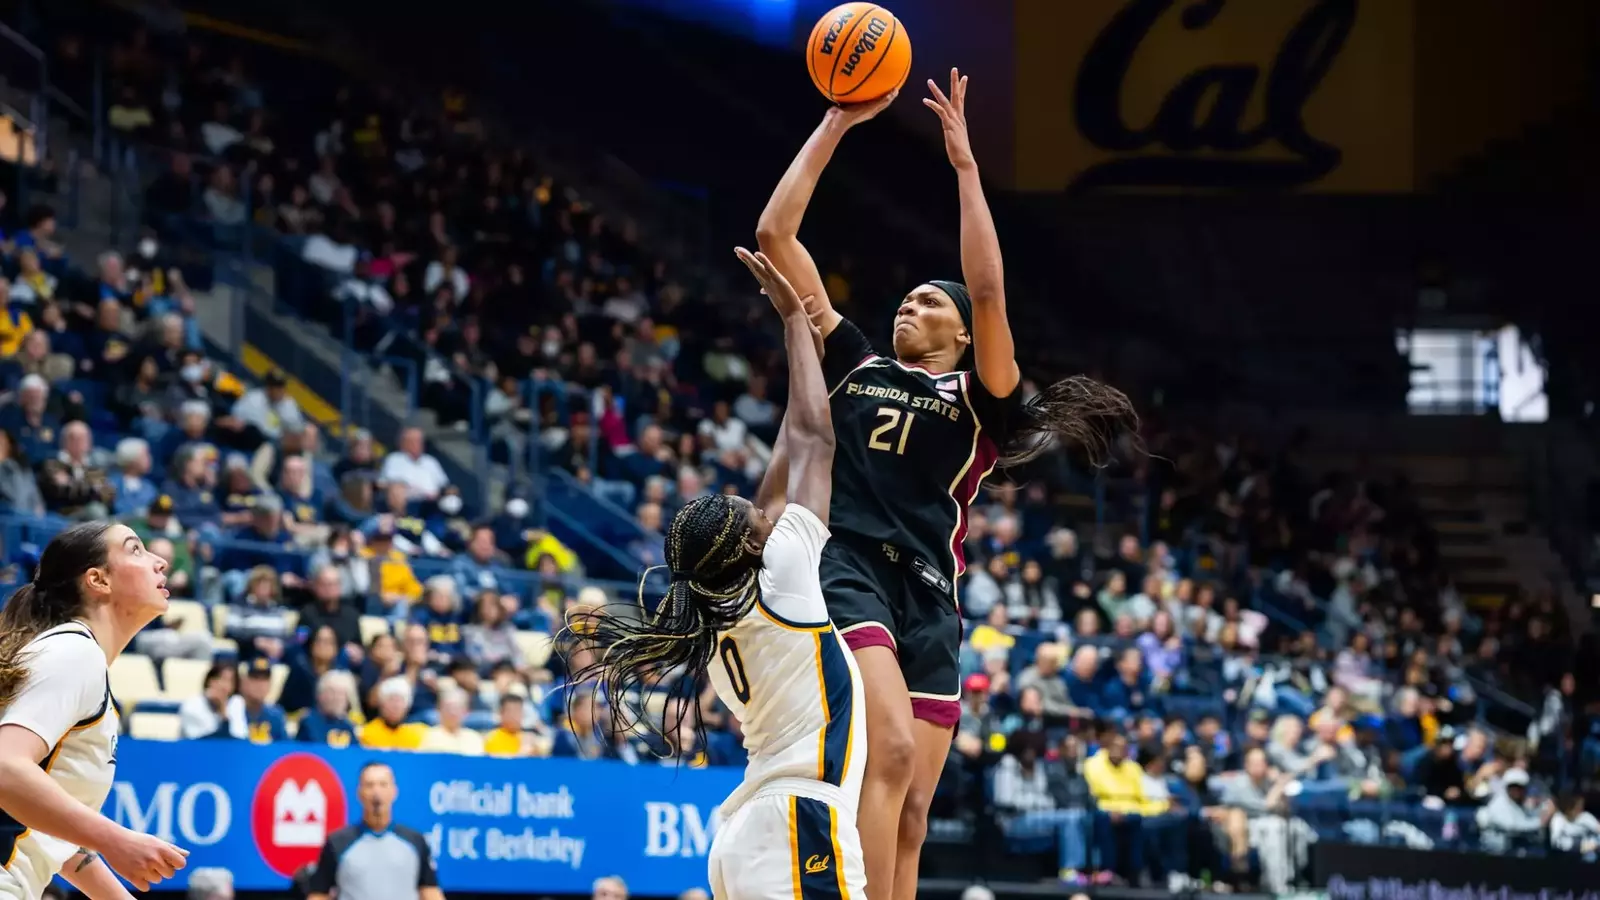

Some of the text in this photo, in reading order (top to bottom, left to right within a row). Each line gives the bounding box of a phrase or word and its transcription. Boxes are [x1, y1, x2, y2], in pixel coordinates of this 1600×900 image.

[820, 10, 854, 55] NCAA
[841, 17, 888, 76] Wilson
[1067, 0, 1360, 192] Cal
[845, 382, 961, 422] FLORIDA STATE
[868, 407, 916, 455] 21
[720, 634, 750, 705] 0
[113, 780, 232, 845] MO
[429, 779, 574, 819] Official bank
[447, 826, 480, 860] UC
[485, 825, 586, 870] Berkeley
[643, 800, 722, 858] BM
[804, 854, 830, 875] Cal
